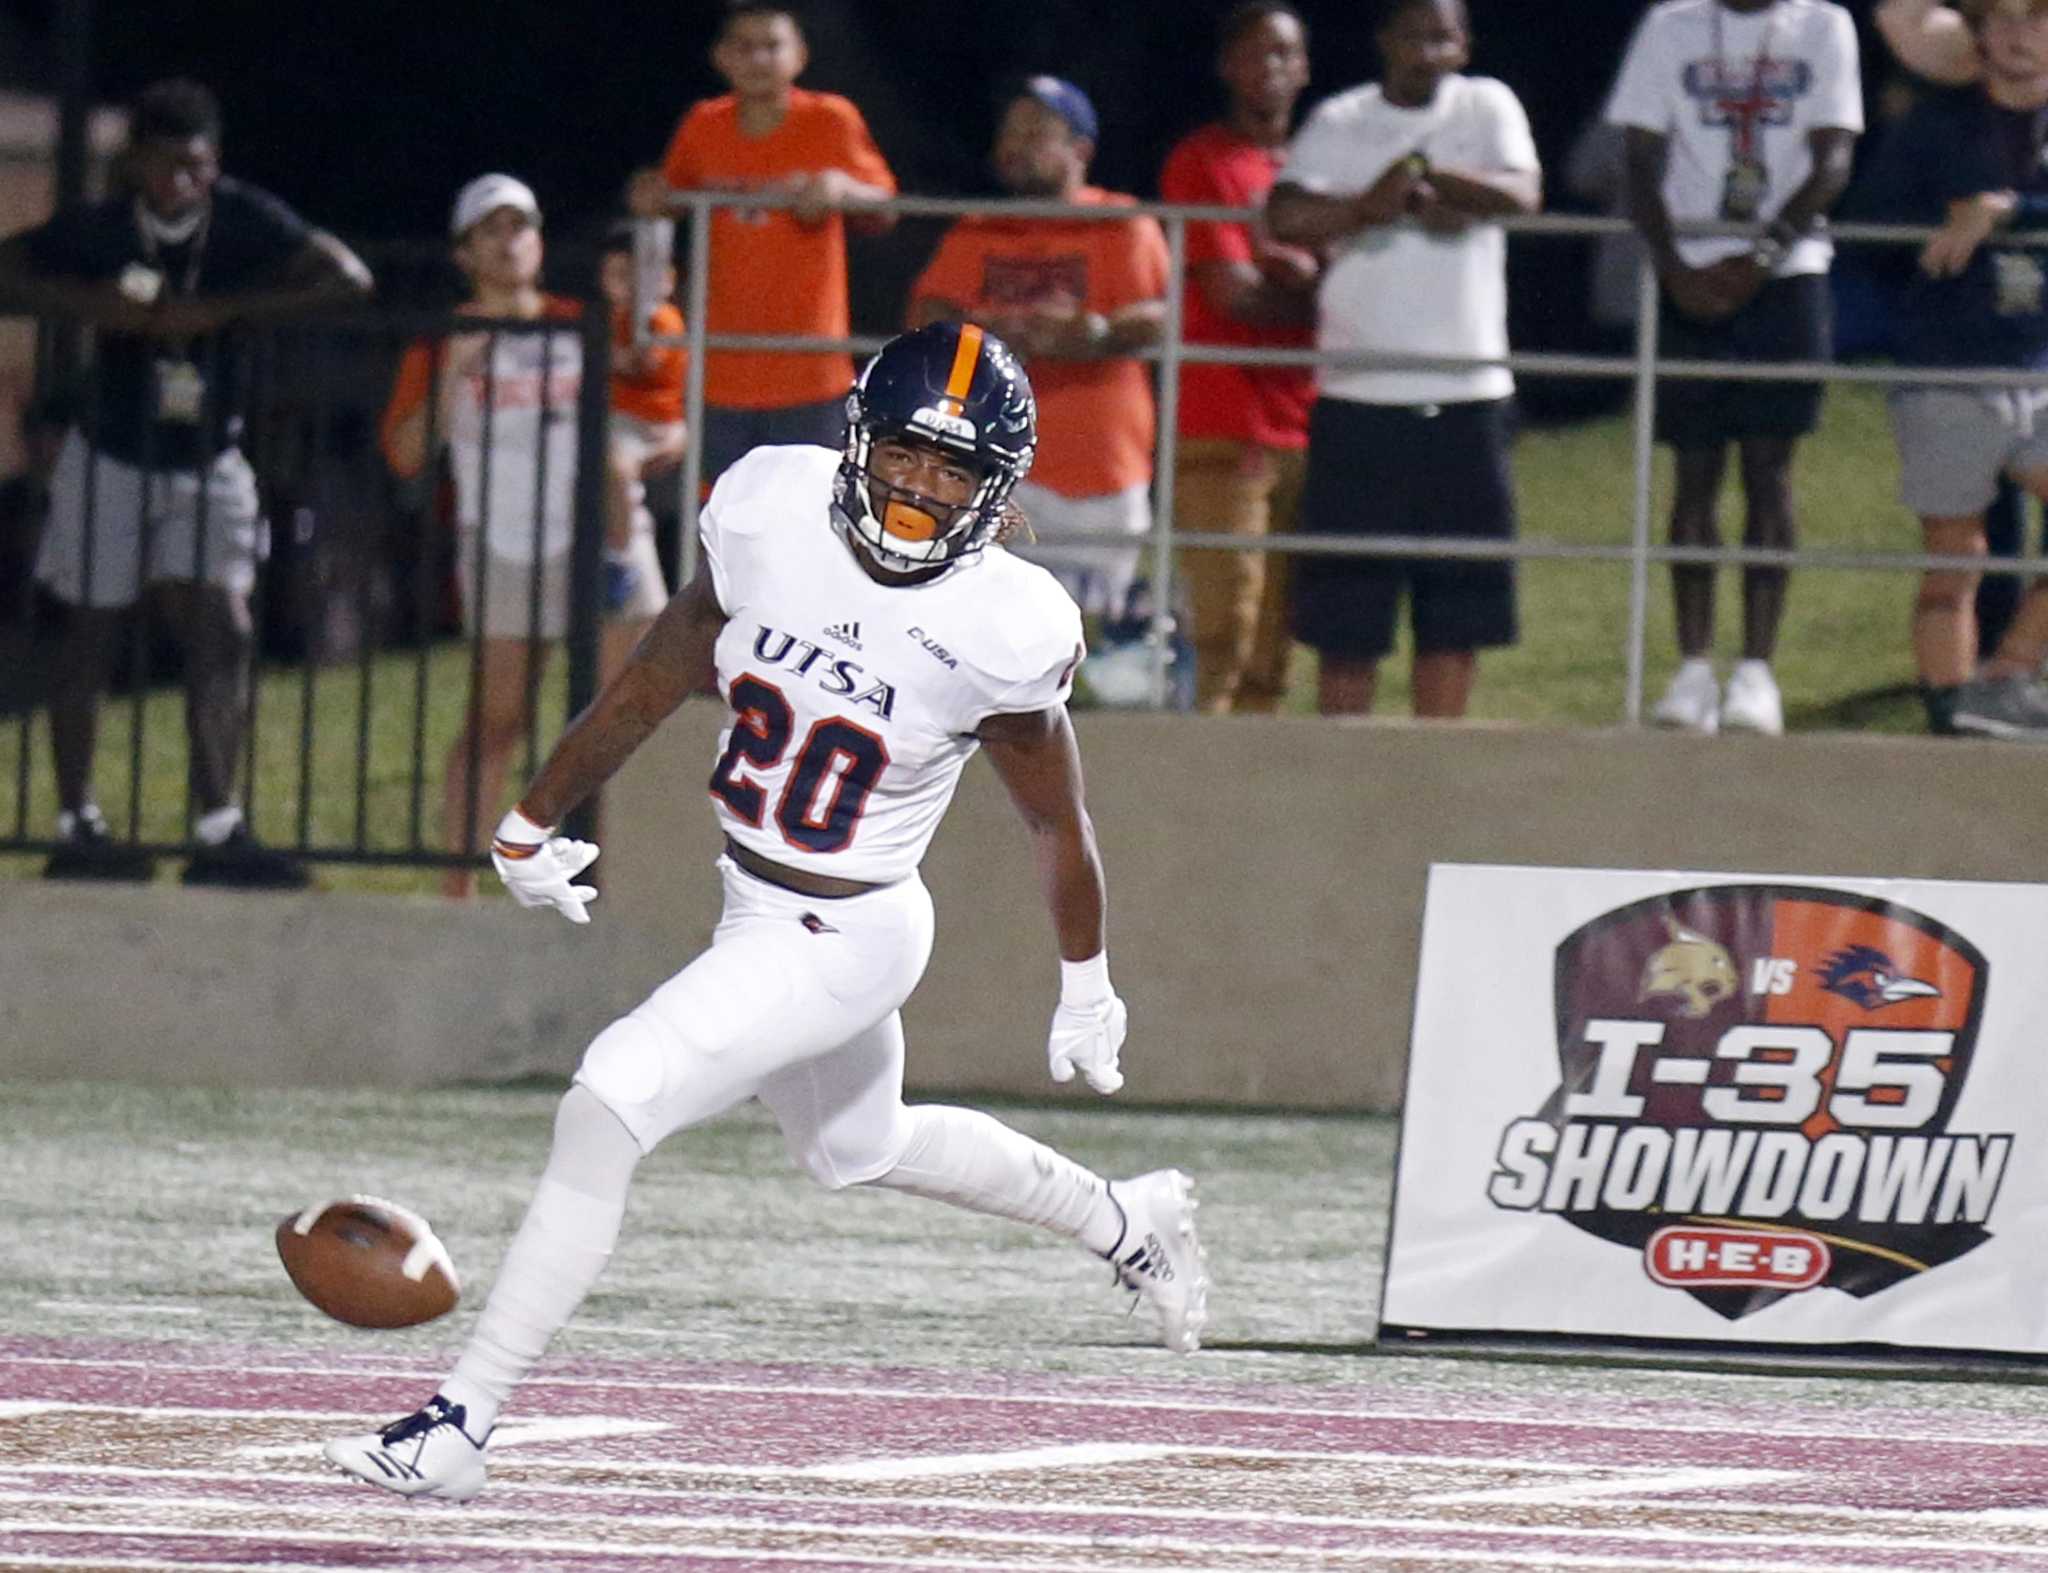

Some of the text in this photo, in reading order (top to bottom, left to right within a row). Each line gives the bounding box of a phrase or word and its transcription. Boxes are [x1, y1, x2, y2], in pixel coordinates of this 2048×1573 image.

[753, 625, 897, 722] UTSA
[822, 627, 863, 651] adidas
[906, 626, 959, 671] C-USA
[708, 671, 891, 855] 20
[1752, 957, 1797, 995] VS
[1565, 1020, 1957, 1129] I-35
[1488, 1117, 2014, 1226] SHOWDOWN
[1667, 1239, 1812, 1277] H-E-B
